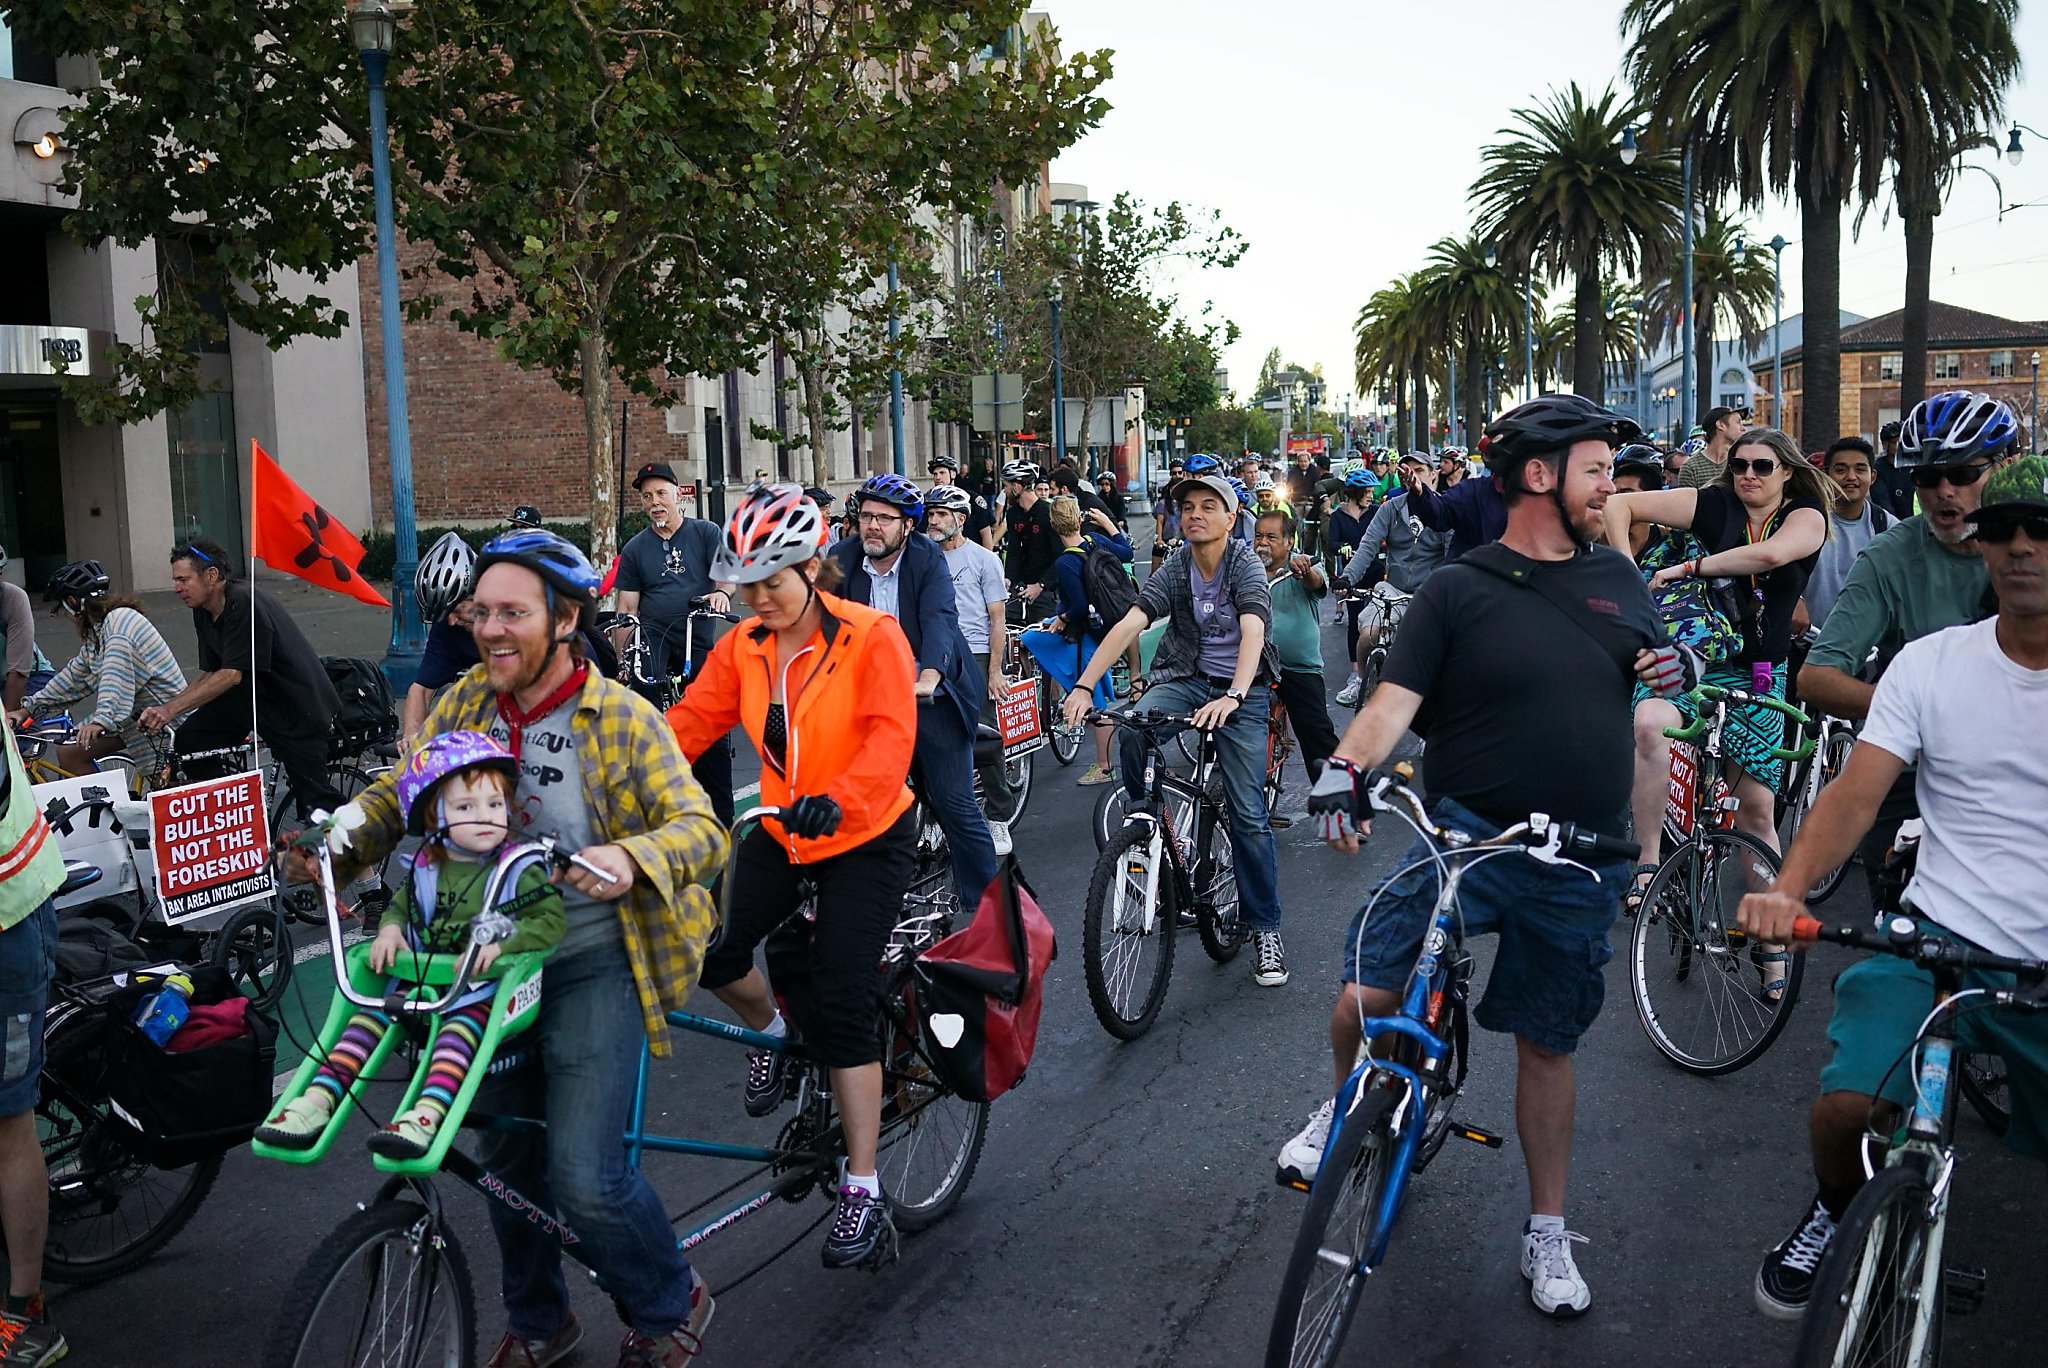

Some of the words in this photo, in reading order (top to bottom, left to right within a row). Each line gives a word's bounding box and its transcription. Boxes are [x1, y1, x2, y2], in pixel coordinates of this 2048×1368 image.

[999, 689, 1028, 707] ORESKIN
[1000, 705, 1014, 718] THE
[1006, 714, 1019, 728] NOT
[1020, 710, 1032, 723] THE
[1006, 721, 1035, 740] WRAPPER
[1671, 757, 1689, 781] NOT
[1686, 769, 1694, 787] A
[169, 793, 208, 818] CUT
[213, 784, 249, 808] THE
[164, 805, 255, 843] BULLSHIT
[171, 838, 211, 865] NOT
[216, 828, 254, 852] THE
[167, 848, 263, 890] FORESKIN
[167, 898, 184, 915] BAY
[187, 891, 211, 910] AREA
[212, 874, 270, 903] INTACTIVISTS
[480, 1171, 580, 1245] MOTIV
[682, 1191, 771, 1252] MOTIV
